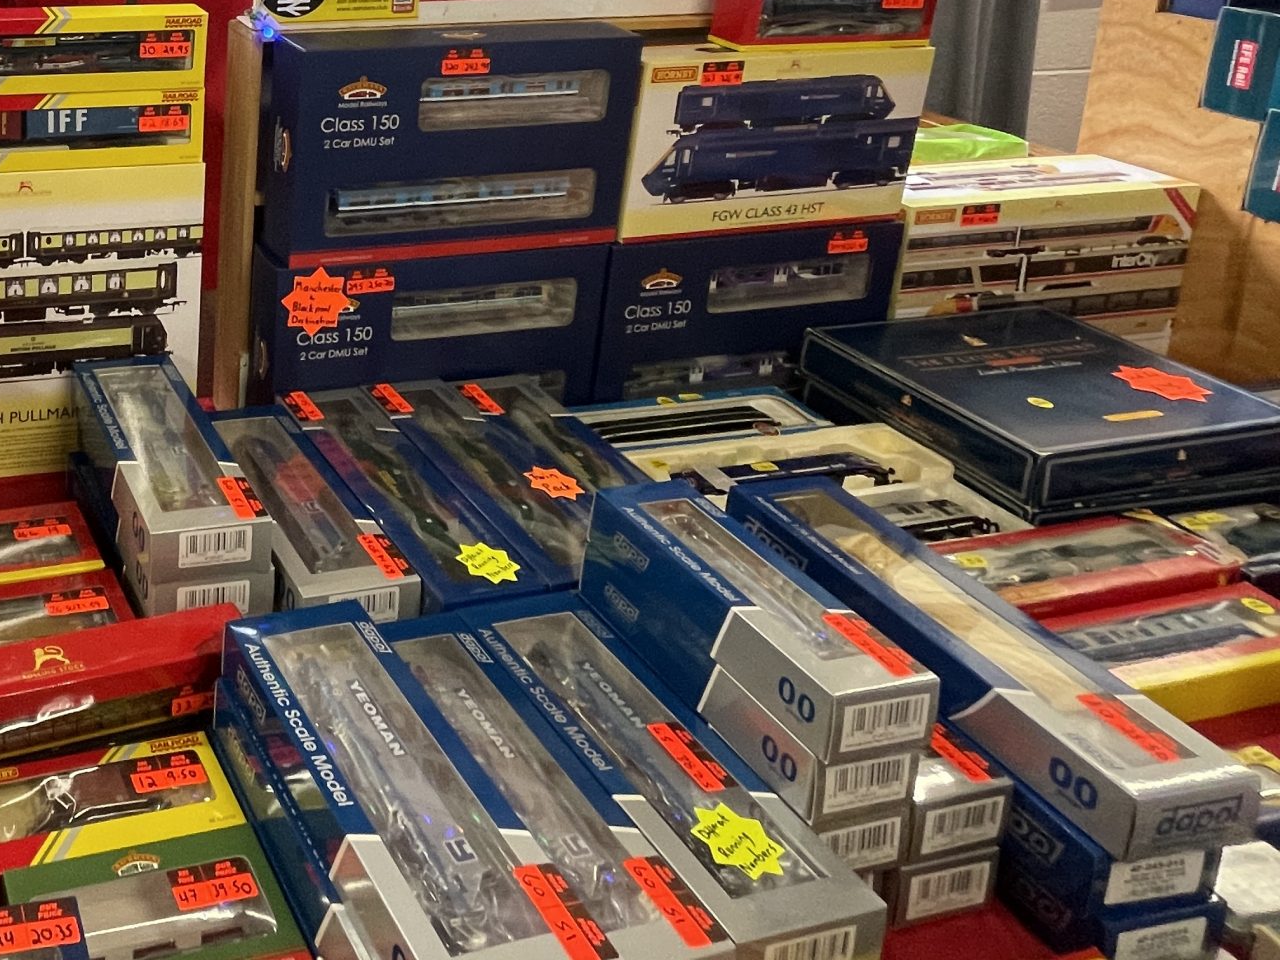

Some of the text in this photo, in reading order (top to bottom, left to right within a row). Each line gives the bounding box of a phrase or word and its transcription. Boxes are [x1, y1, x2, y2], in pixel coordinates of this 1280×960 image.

[165, 17, 203, 26] RAILROAD
[655, 68, 696, 81] HORNBY
[1234, 43, 1255, 87] EFE Rail
[161, 91, 199, 101] RAILROAD
[48, 109, 88, 134] IFF
[320, 114, 400, 133] Class 150
[324, 136, 395, 149] 2 Car DMU Set
[712, 202, 825, 222] FGW CLASS 43 HST
[1111, 252, 1158, 269] InterCity
[295, 281, 341, 293] Manchester
[624, 299, 692, 320] Class 150
[296, 326, 373, 346] Class 150
[626, 318, 687, 334] 2 Car DMU Set
[300, 346, 368, 361] 2 Car DMU Set
[621, 506, 671, 546] Authentic
[668, 544, 703, 572] Scale
[58, 662, 87, 673] STOCK
[477, 628, 614, 772] Authentic Scale Model
[582, 662, 648, 729] YEOMAN
[244, 642, 290, 708] Authentic
[284, 708, 317, 752] Scale
[310, 753, 355, 808] Model
[349, 679, 406, 757] YEOMAN
[457, 688, 516, 759] YEOMAN
[150, 736, 200, 751] RAILROAD
[138, 769, 197, 788] 12 9.50
[1156, 802, 1242, 836] dapol
[178, 888, 197, 904] 47
[633, 865, 685, 925] 60 51
[521, 873, 578, 941] 60 51
[30, 923, 73, 946] 20.35
